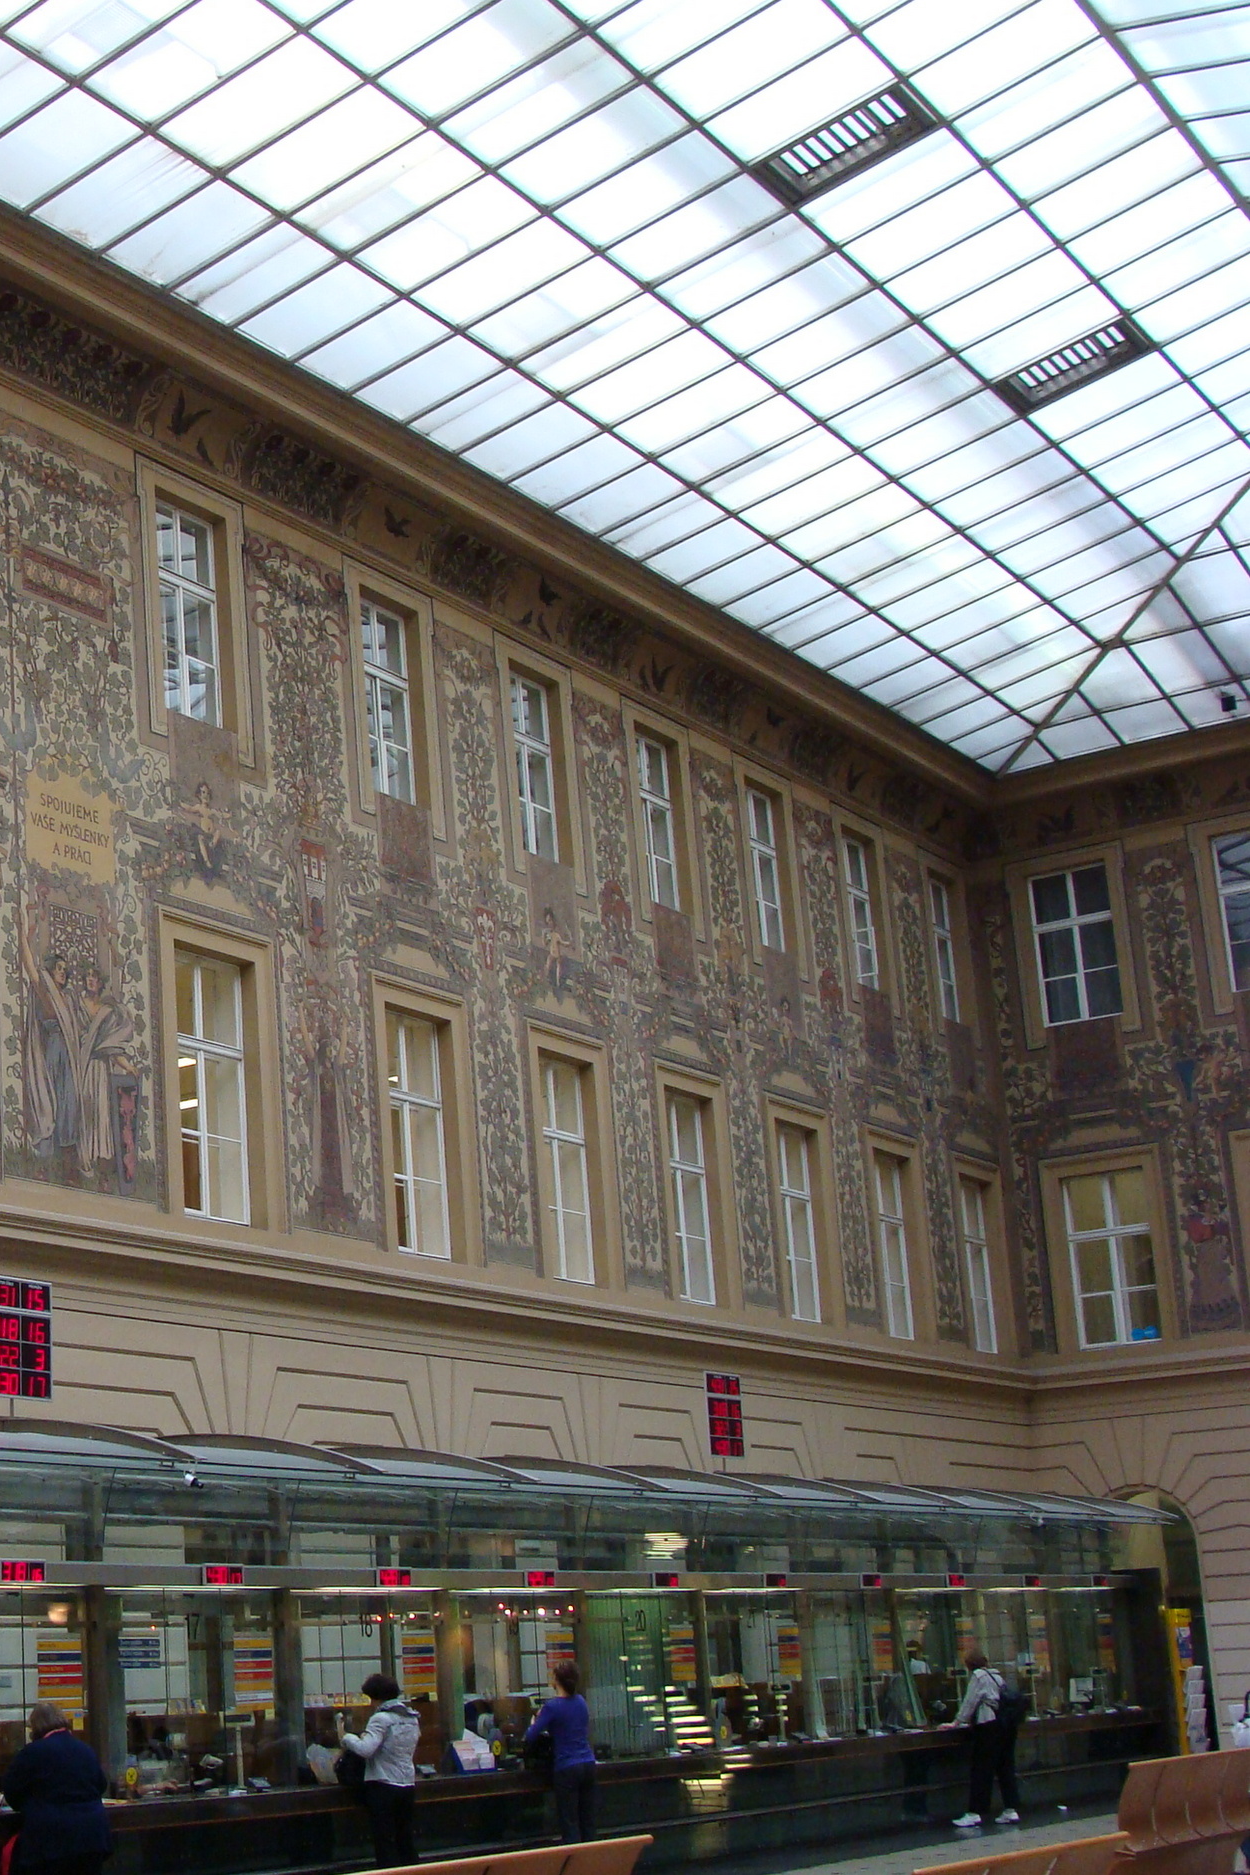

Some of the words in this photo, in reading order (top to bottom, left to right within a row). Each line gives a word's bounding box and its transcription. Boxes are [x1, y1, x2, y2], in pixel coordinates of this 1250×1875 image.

[40, 793, 99, 824] SPOJUJEME
[30, 811, 56, 832] VAŠE
[59, 821, 110, 848] MYŠLENKY
[52, 842, 61, 856] A
[28, 1289, 44, 1311] 15
[29, 1321, 45, 1344] 16
[35, 1349, 45, 1371] 3
[30, 1376, 46, 1398] 17
[184, 1613, 199, 1640] 17
[634, 1609, 647, 1631] 20
